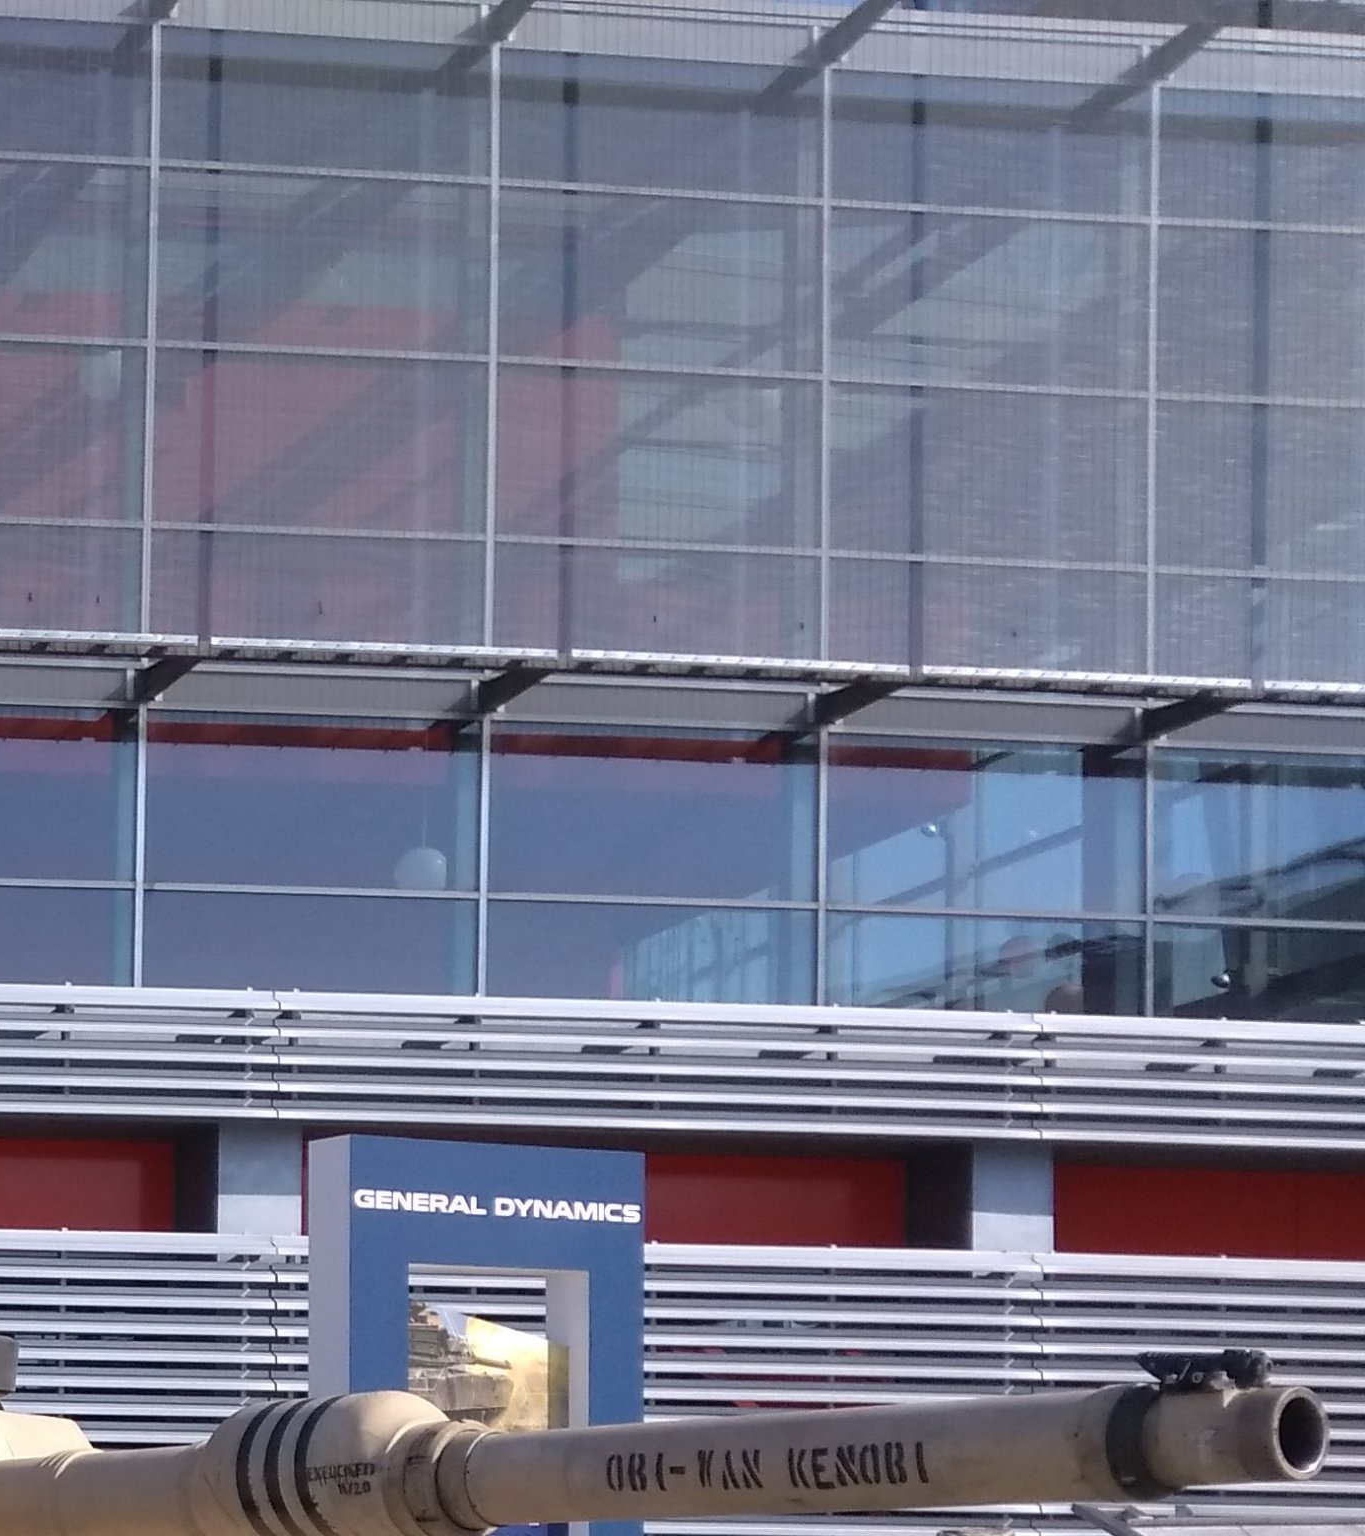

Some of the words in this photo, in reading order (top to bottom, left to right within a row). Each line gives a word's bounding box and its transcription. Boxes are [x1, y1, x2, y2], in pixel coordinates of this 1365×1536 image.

[354, 1188, 488, 1217] GENERAL
[495, 1197, 641, 1224] DYNAMICS
[787, 1441, 929, 1490] KENOBI
